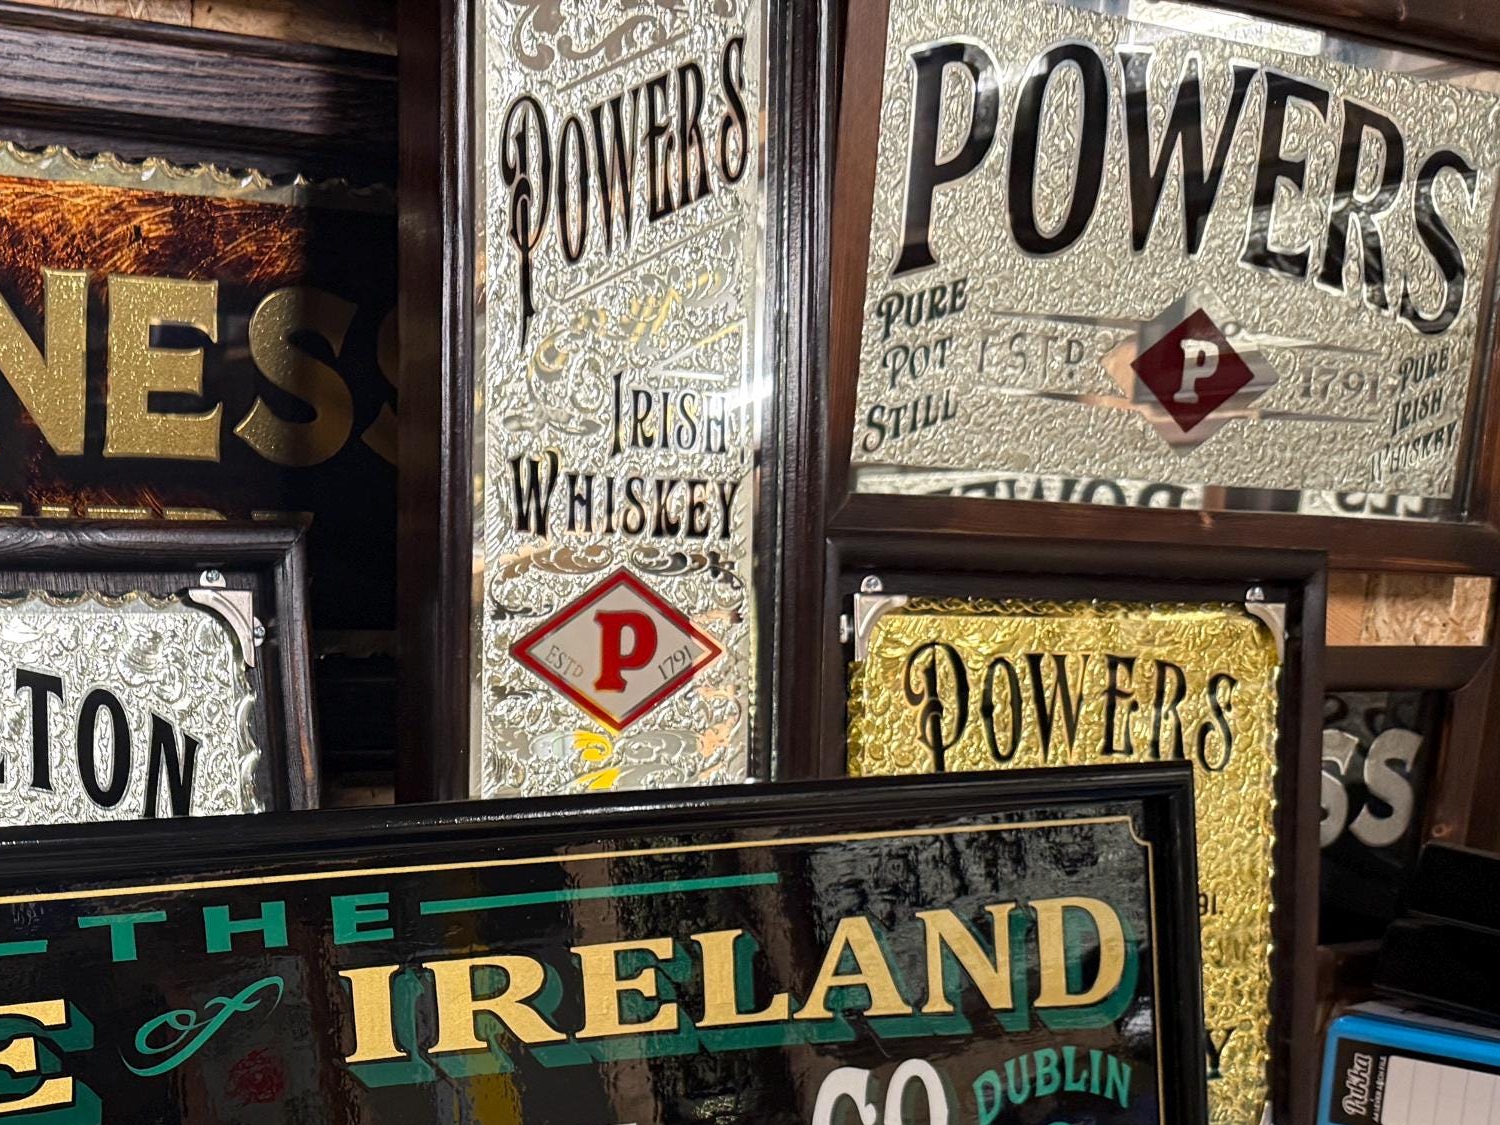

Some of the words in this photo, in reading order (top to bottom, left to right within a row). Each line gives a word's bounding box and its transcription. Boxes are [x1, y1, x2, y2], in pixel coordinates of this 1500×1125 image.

[503, 36, 749, 352] POWERS
[889, 38, 1479, 334] POWERS
[875, 277, 969, 342] PURE
[882, 337, 953, 390] POT
[1173, 338, 1220, 403] P
[1399, 348, 1449, 393] PURE
[611, 371, 727, 457] IRISH
[862, 389, 958, 452] STILL
[1390, 388, 1444, 438] IRISH
[509, 451, 740, 538] WHISKEY
[545, 644, 584, 678] ESTD
[592, 609, 658, 693] P
[657, 647, 692, 681] 1791
[903, 642, 1237, 773] POWERS
[77, 891, 395, 963] THE
[119, 975, 285, 1077] of
[338, 896, 1128, 1066] IRELAND
[1342, 1051, 1373, 1115] Pukka
